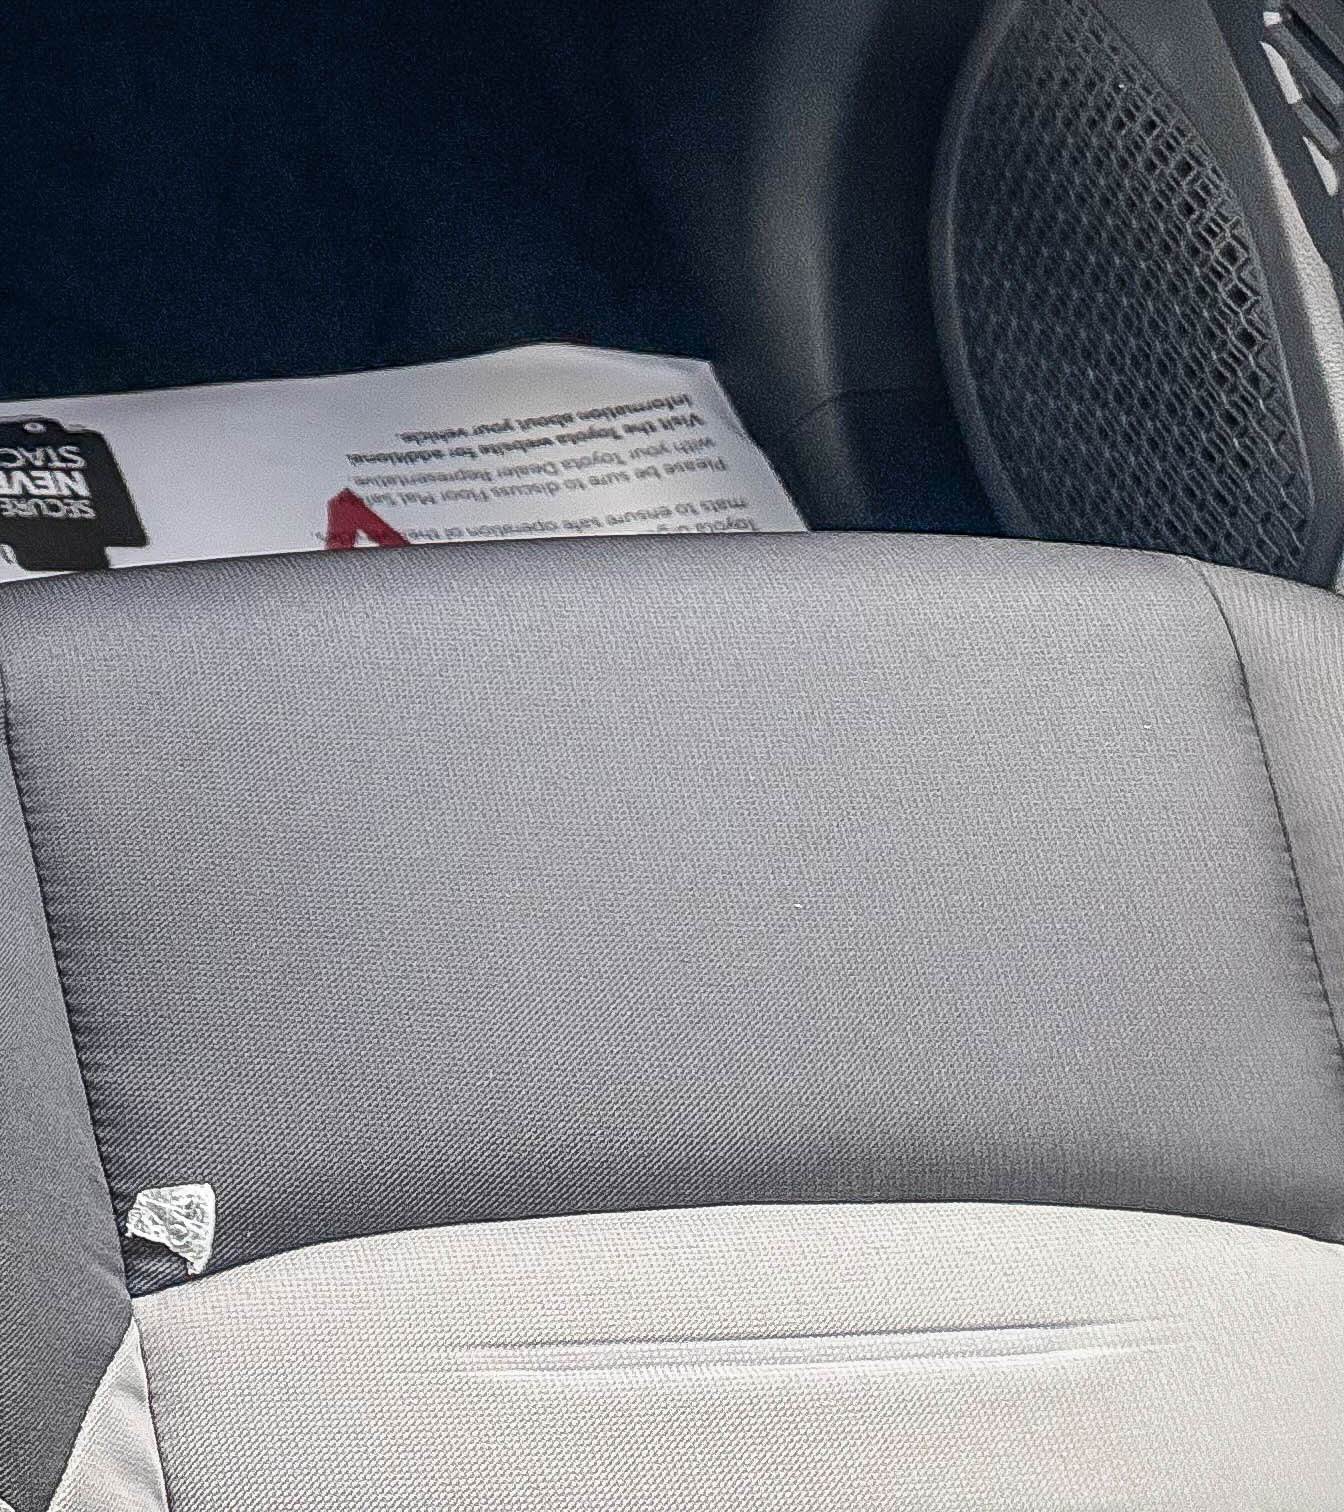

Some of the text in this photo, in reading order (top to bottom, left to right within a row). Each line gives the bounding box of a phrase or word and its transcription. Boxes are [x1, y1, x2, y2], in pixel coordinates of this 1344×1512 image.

[575, 392, 693, 421] information
[472, 418, 514, 437] your
[515, 413, 575, 431] about
[621, 420, 658, 436] the
[657, 412, 705, 431] Visit
[555, 425, 623, 446] Toyota
[628, 441, 671, 460] your
[561, 450, 628, 471] Toyota
[662, 456, 728, 476] Please
[588, 471, 631, 487] sure
[634, 465, 662, 480] be
[490, 480, 562, 498] discuss
[562, 476, 587, 490] to
[0, 499, 98, 519] SECURE
[606, 506, 673, 526] ensure
[675, 502, 700, 516] to
[466, 519, 559, 537] operation
[562, 516, 604, 534] safe
